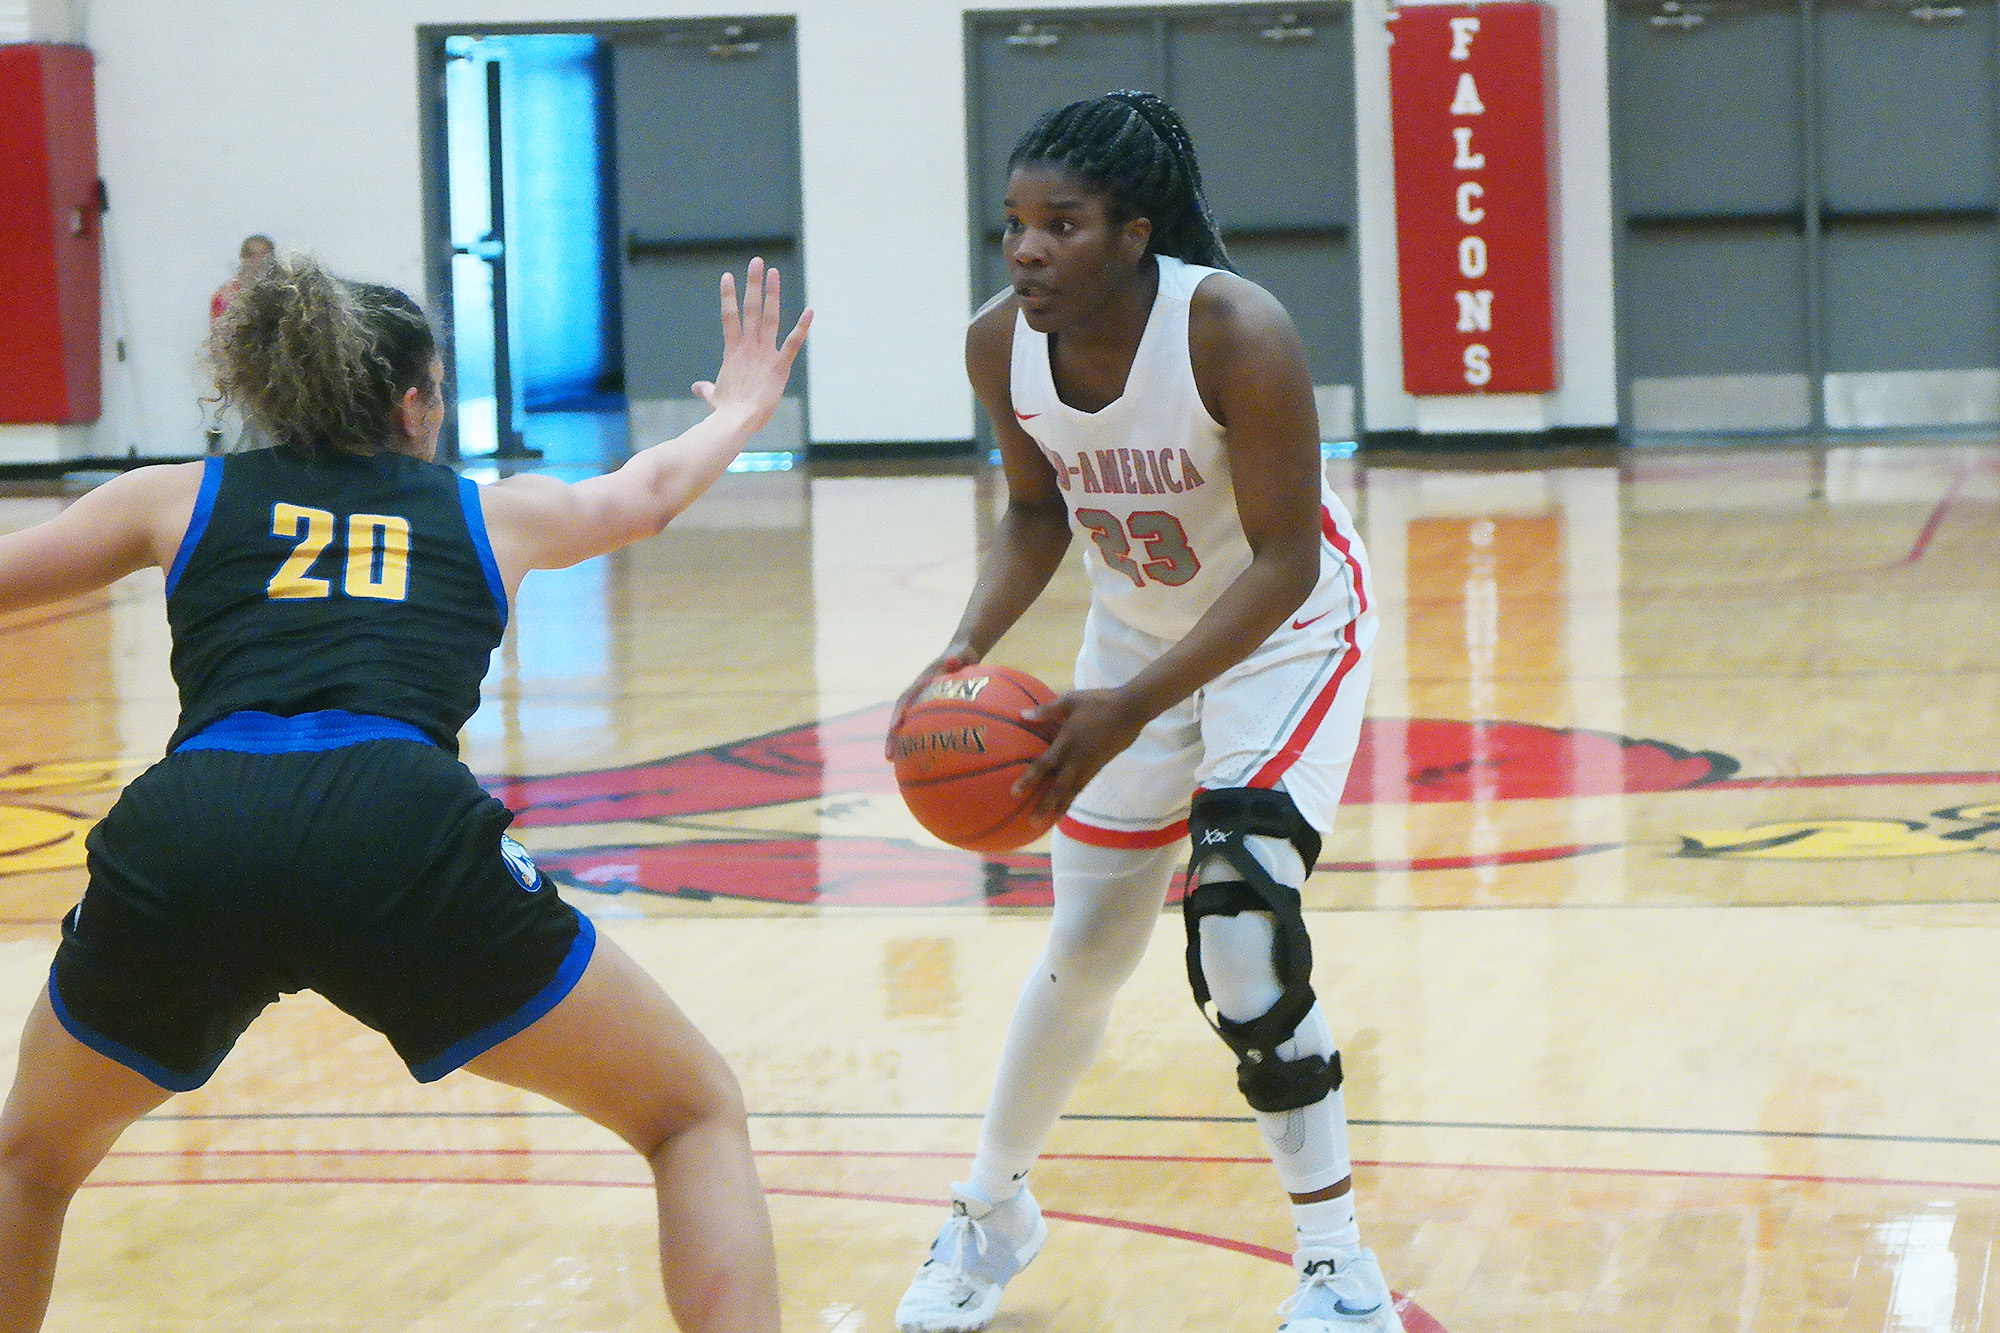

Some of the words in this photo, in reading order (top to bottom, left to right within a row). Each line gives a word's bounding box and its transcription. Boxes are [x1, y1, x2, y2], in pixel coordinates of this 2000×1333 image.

[1449, 17, 1494, 386] FALCONS
[264, 501, 412, 602] 20
[1075, 507, 1201, 587] 23
